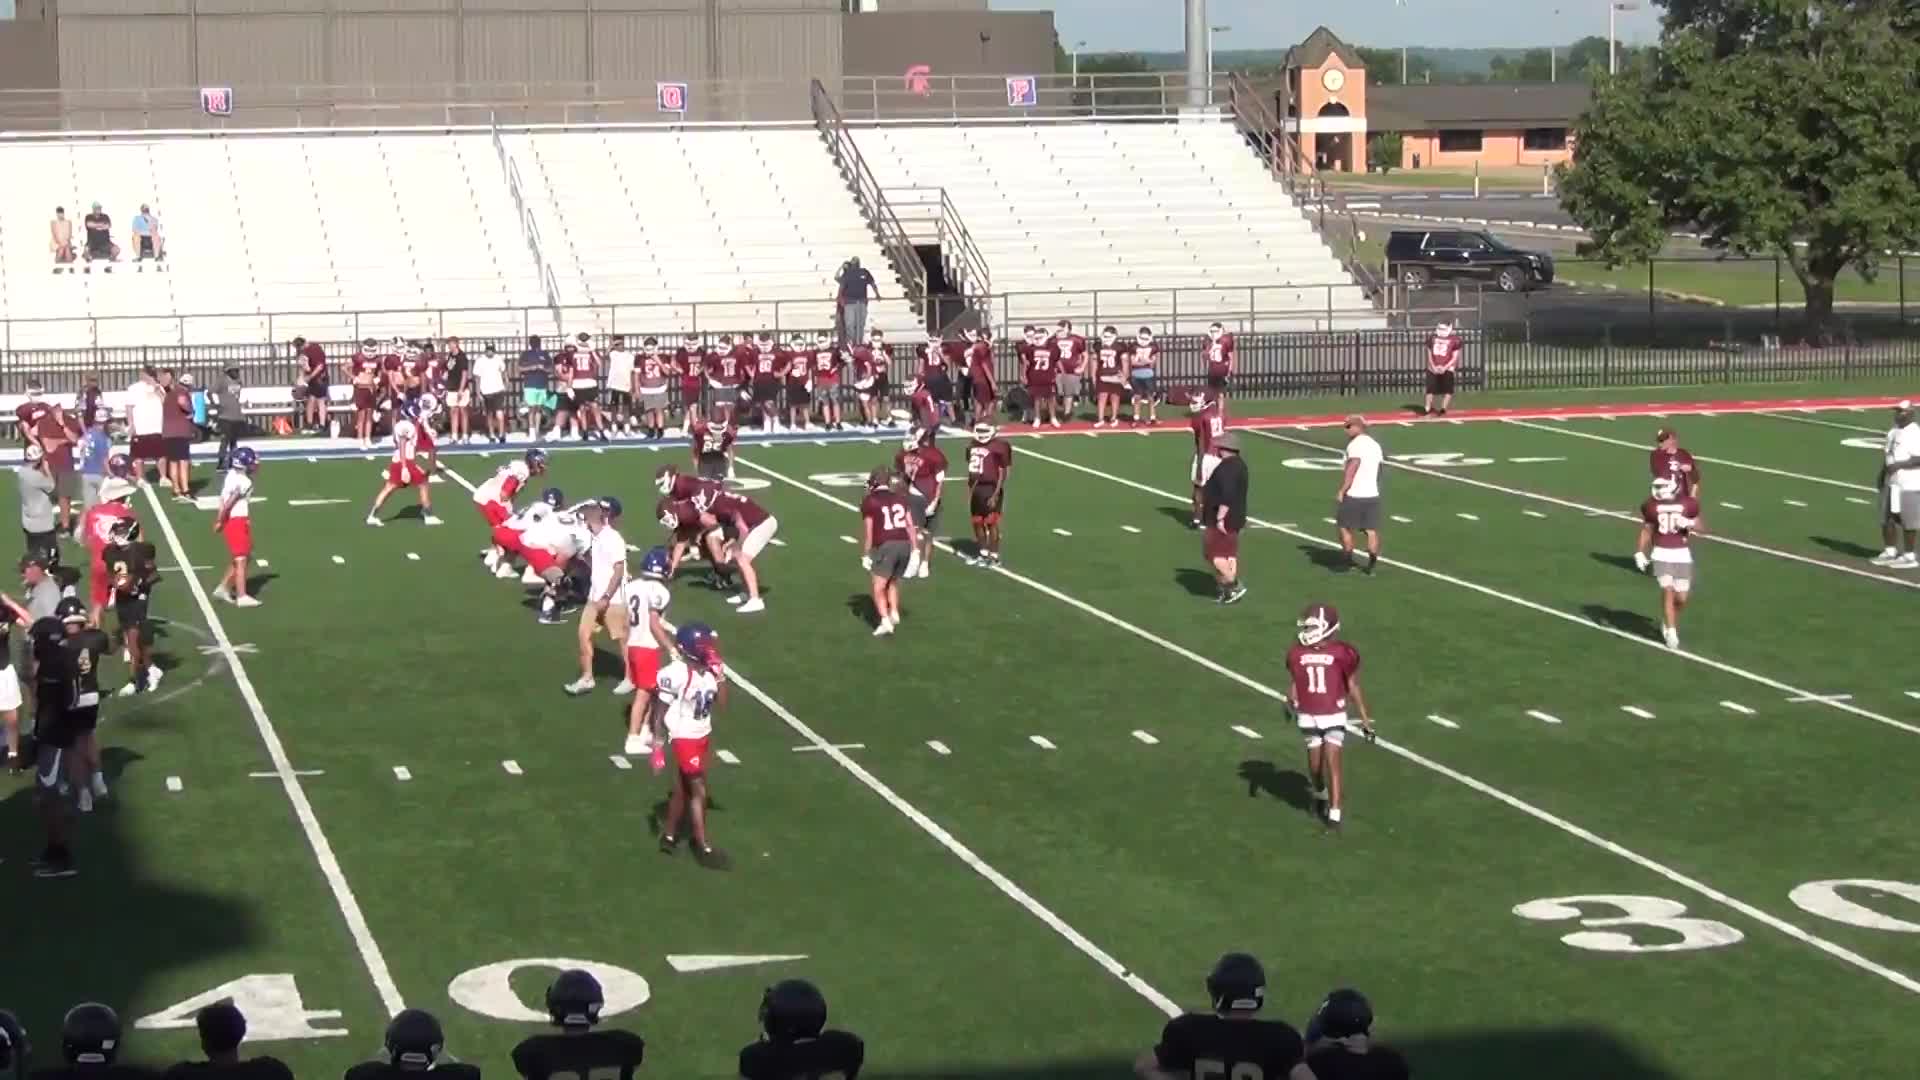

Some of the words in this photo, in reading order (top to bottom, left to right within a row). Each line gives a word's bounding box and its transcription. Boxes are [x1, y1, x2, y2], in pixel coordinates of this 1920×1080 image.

[881, 503, 906, 531] 12
[629, 595, 640, 627] 3
[1305, 666, 1327, 694] 11
